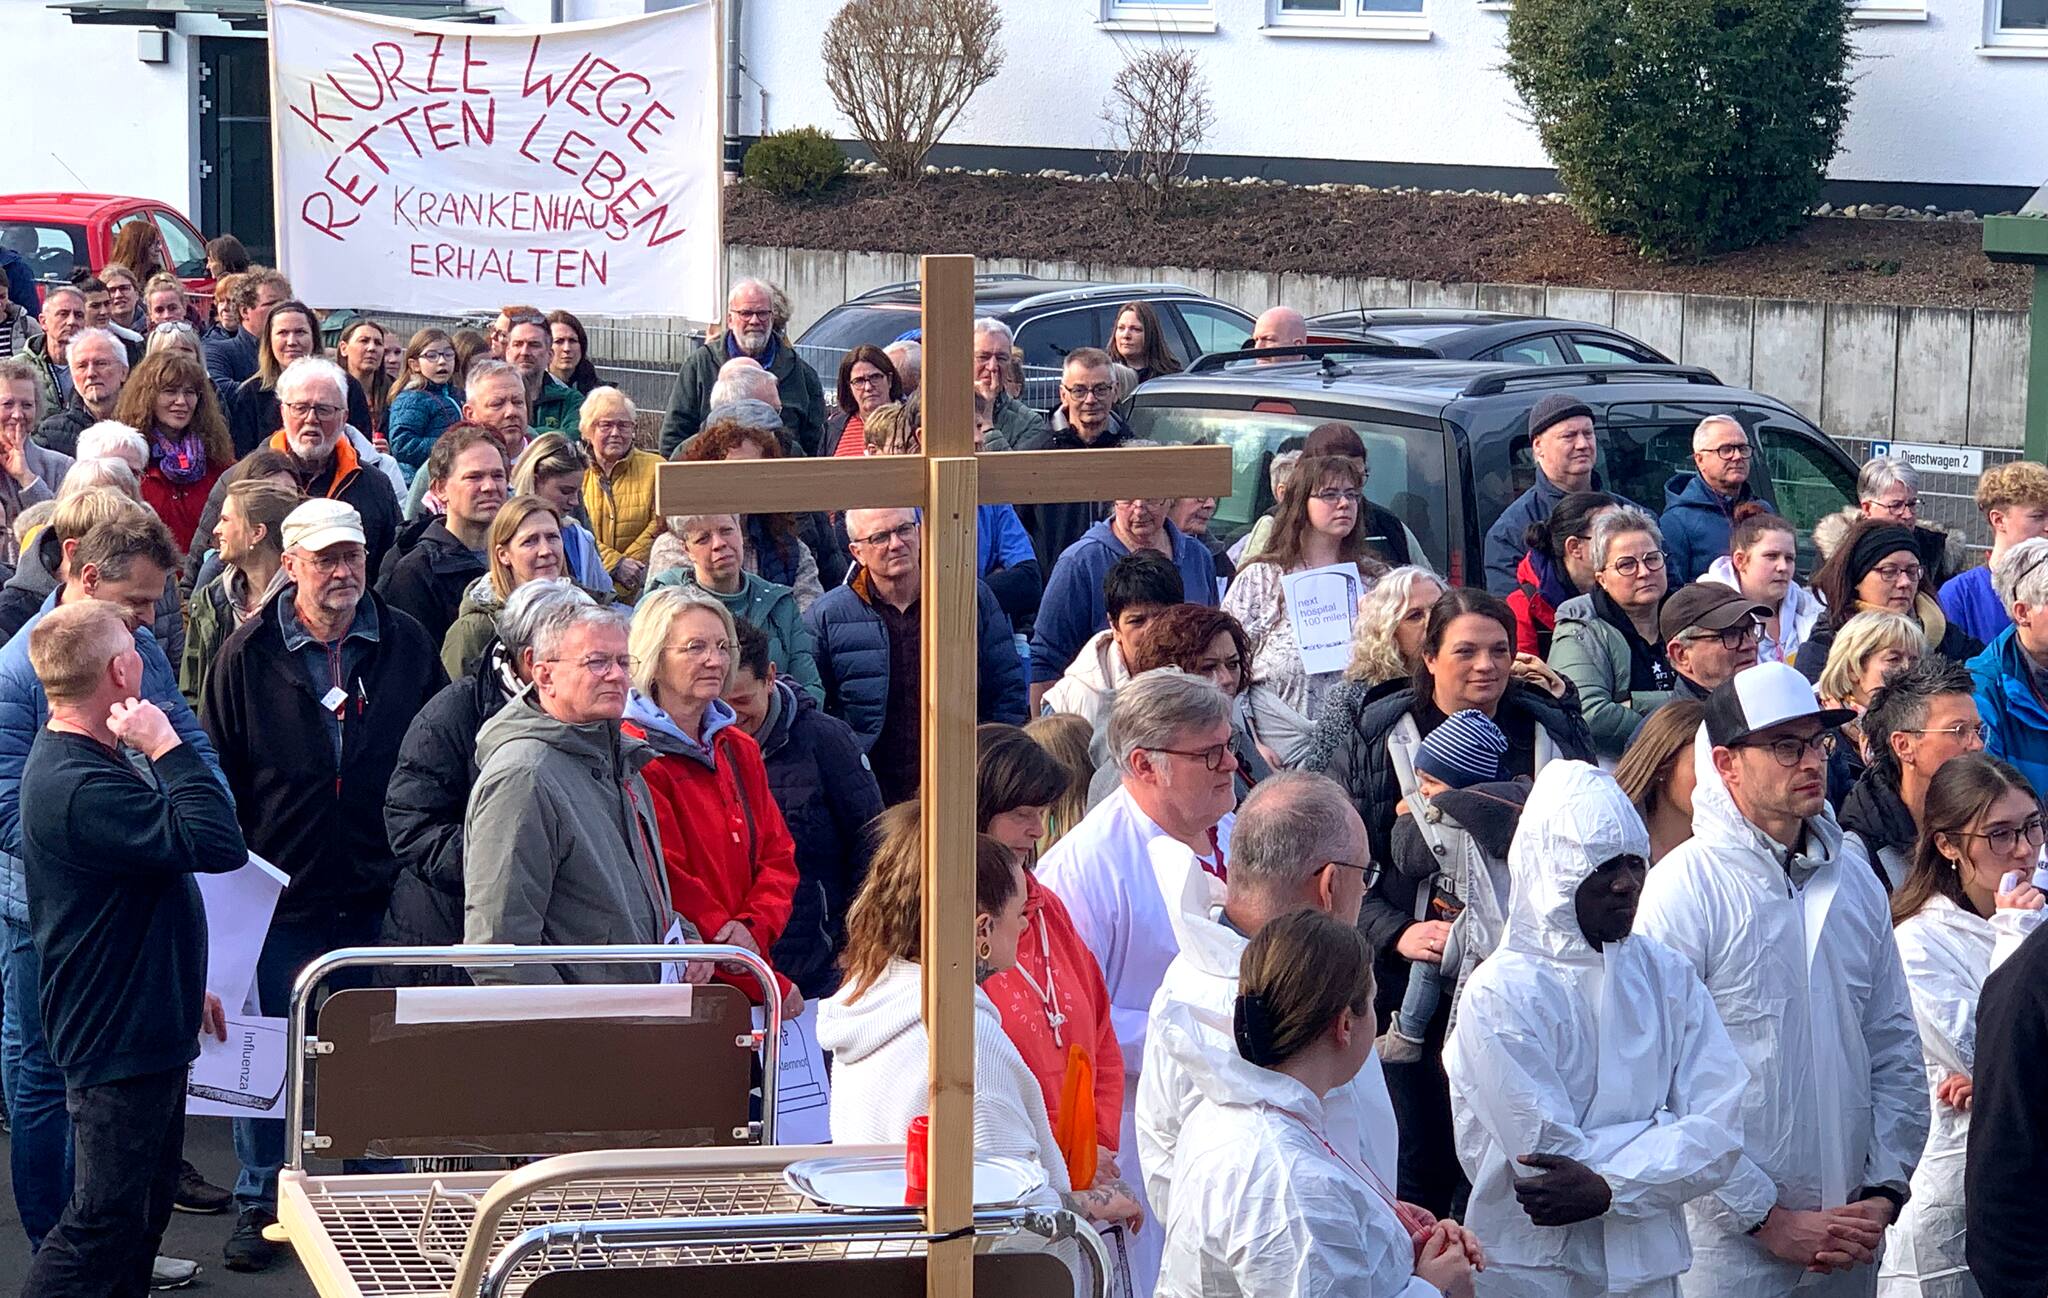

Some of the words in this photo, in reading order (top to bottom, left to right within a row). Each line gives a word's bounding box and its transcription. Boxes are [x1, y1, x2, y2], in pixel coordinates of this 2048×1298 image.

[290, 32, 490, 142] KURZE
[522, 35, 675, 154] WEGE
[302, 97, 496, 241] RETTEN
[519, 114, 685, 248] LEBEN
[394, 185, 629, 240] KRANKENHAUS
[411, 243, 607, 288] ERHALTEN
[1901, 449, 1960, 470] Dienstwagen
[1962, 454, 1969, 468] 2
[1298, 597, 1318, 607] next
[1300, 603, 1336, 617] hospital
[1304, 617, 1320, 627] 100
[1323, 612, 1347, 623] miles
[239, 1031, 256, 1090] Influenza
